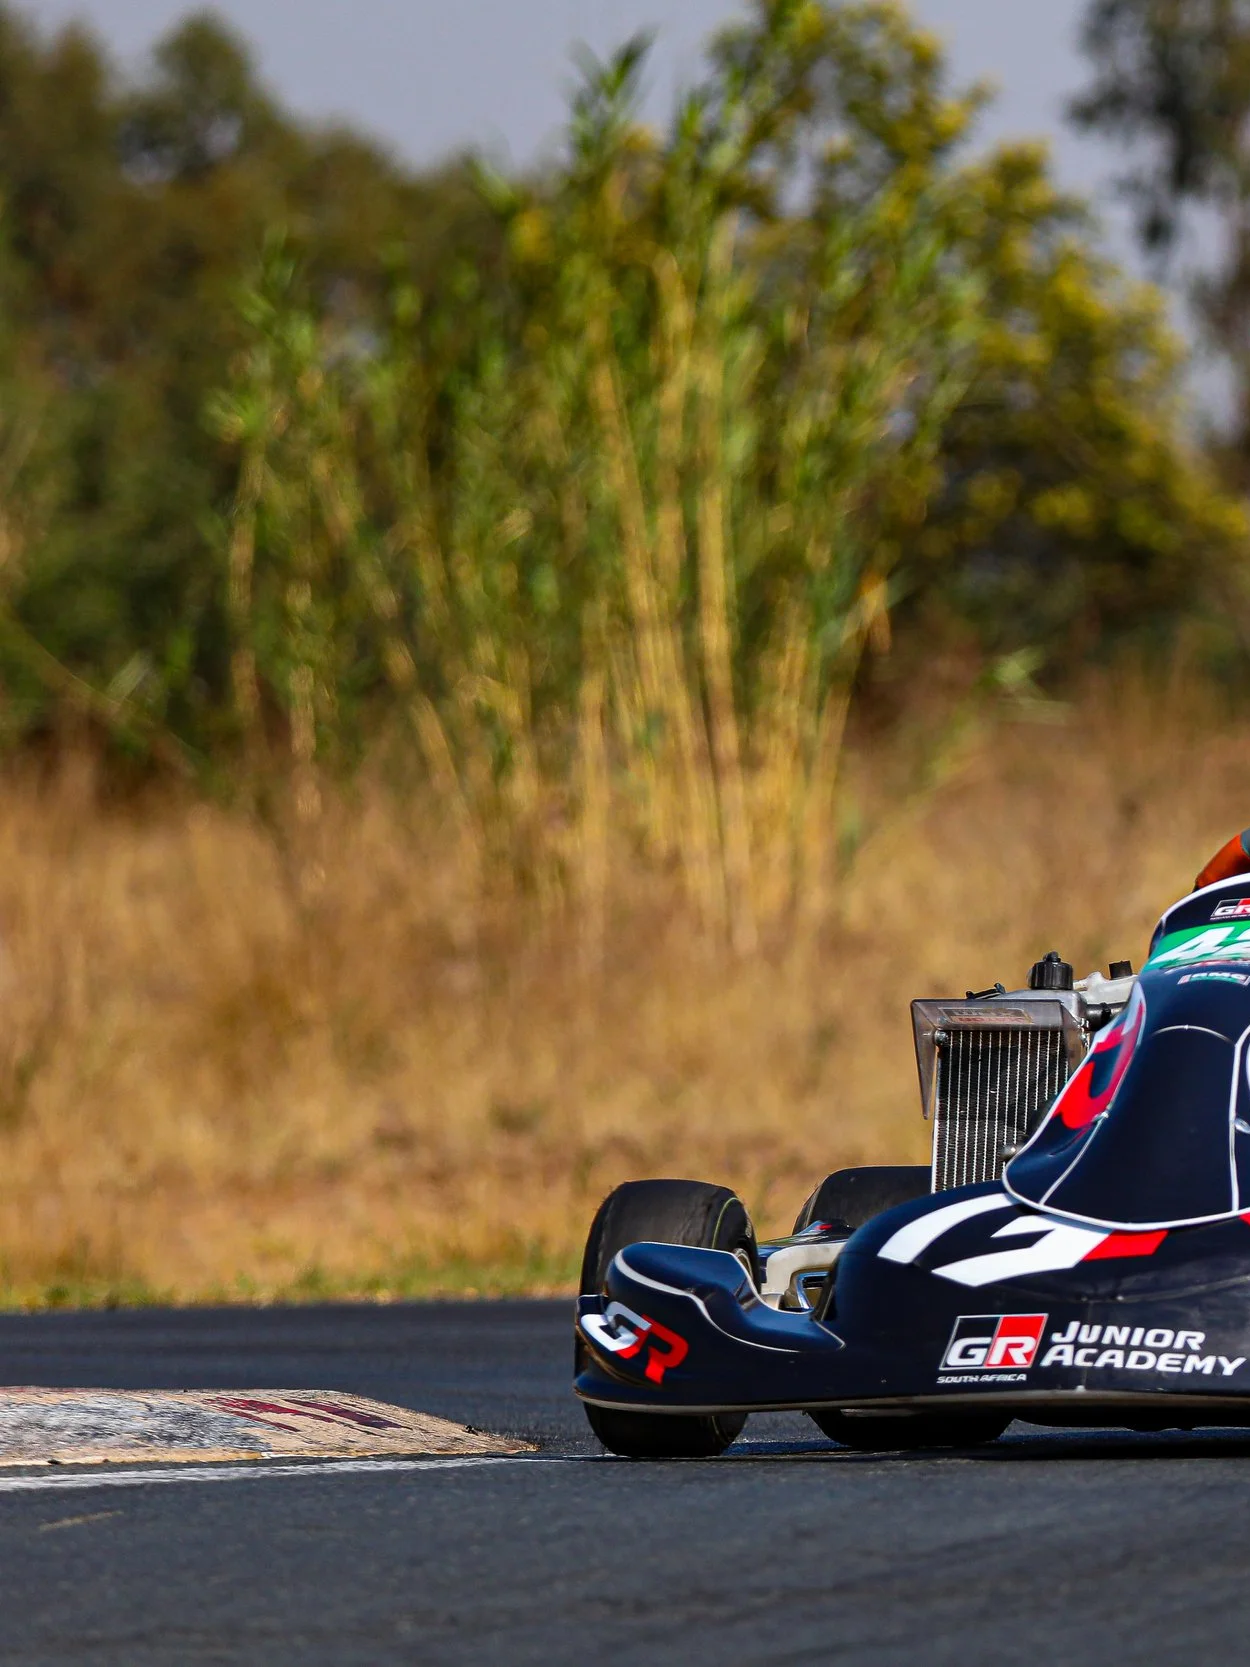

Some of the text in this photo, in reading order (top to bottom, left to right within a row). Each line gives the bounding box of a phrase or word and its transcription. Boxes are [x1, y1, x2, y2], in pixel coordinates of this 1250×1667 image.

[579, 1301, 689, 1385] GR
[945, 1320, 1206, 1367] GR JUNIOR
[1040, 1344, 1247, 1377] ACADEMY
[937, 1373, 1027, 1384] SOUTH AFRICA
